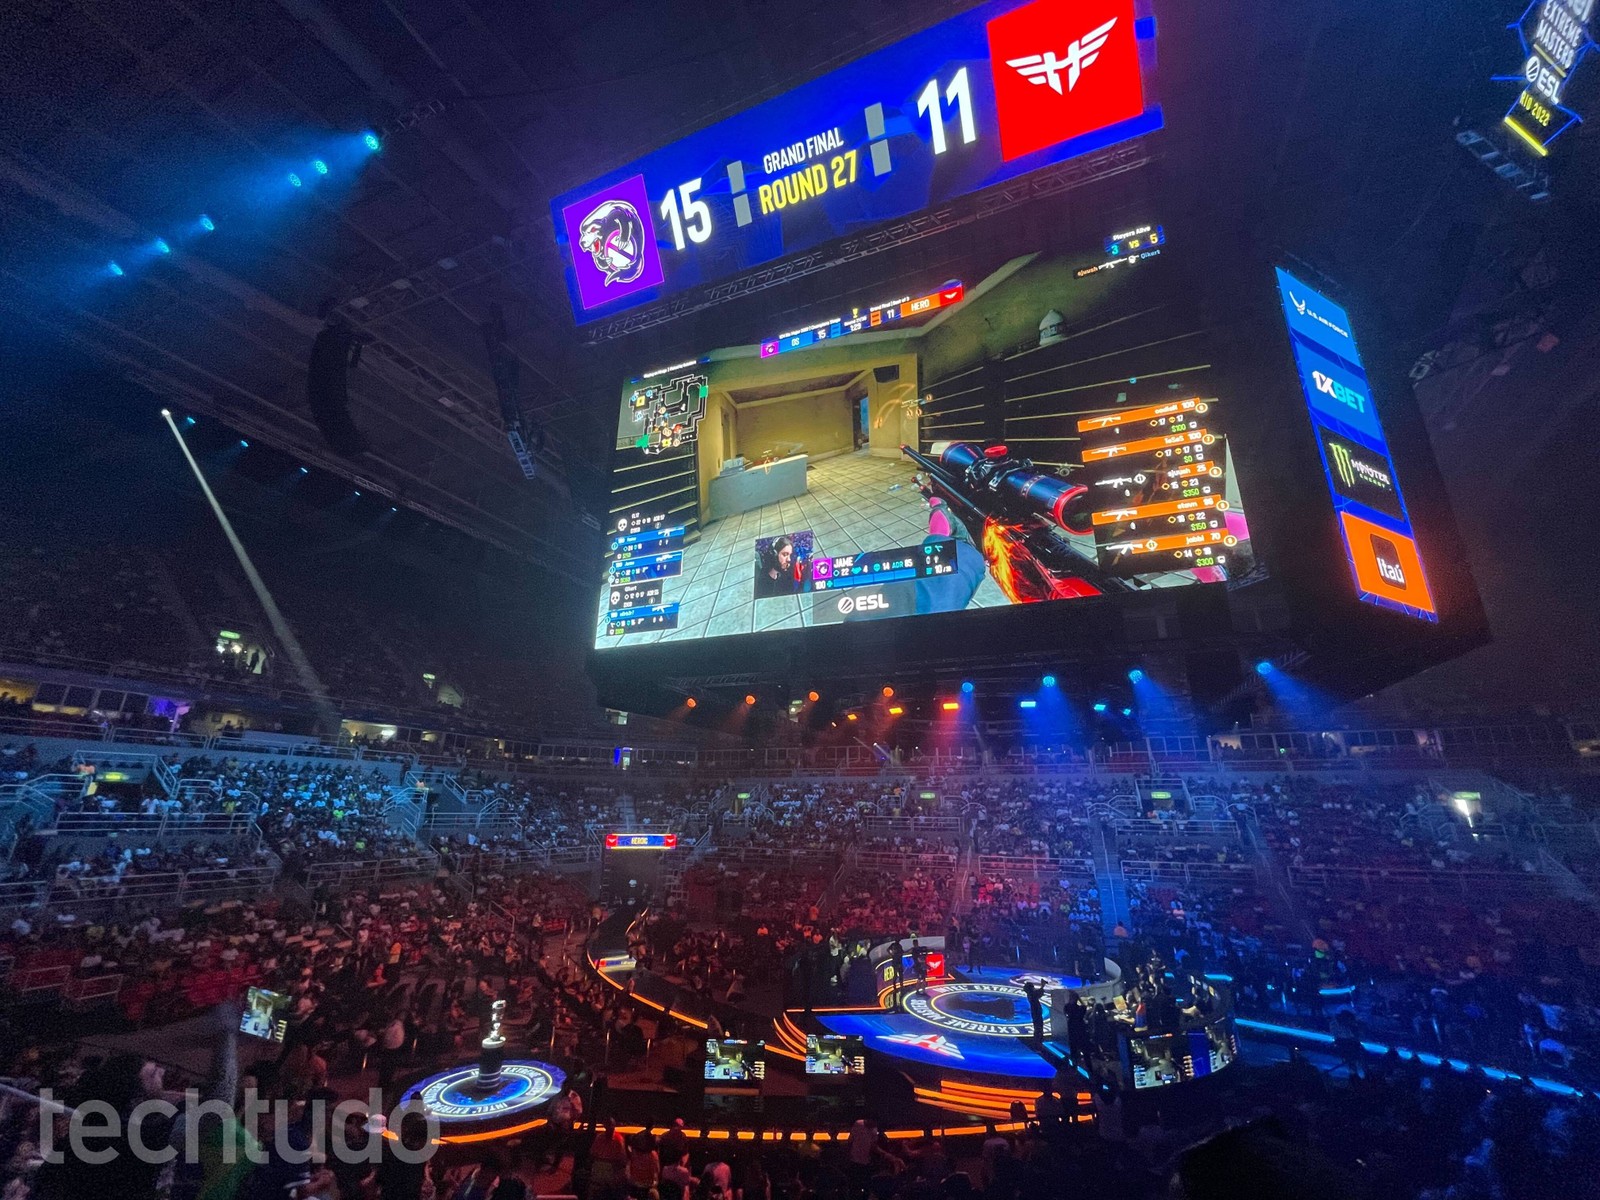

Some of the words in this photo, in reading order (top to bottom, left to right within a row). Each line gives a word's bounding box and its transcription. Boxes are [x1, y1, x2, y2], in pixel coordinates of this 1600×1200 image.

[1544, 0, 1582, 46] EXTREME
[1537, 68, 1560, 105] ESL
[918, 66, 976, 155] 11
[1532, 102, 1550, 126] 2022
[762, 142, 806, 174] GRAND
[806, 127, 844, 156] FINAL
[758, 163, 828, 215] ROUND
[830, 150, 858, 188] 27
[660, 177, 713, 251] 15
[1112, 244, 1118, 255] 3
[1150, 233, 1158, 244] 5
[887, 309, 894, 318] 11
[910, 300, 930, 312] HERO
[818, 329, 826, 339] 15
[1312, 370, 1365, 414] 1XBET
[834, 557, 854, 568] JAME
[862, 565, 868, 573] 4
[882, 562, 890, 570] 14
[1376, 557, 1405, 584] Itaú
[815, 580, 826, 590] 100
[856, 594, 889, 611] ESL
[974, 986, 1027, 996] EXTREM
[944, 1018, 1020, 1034] EXTREME
